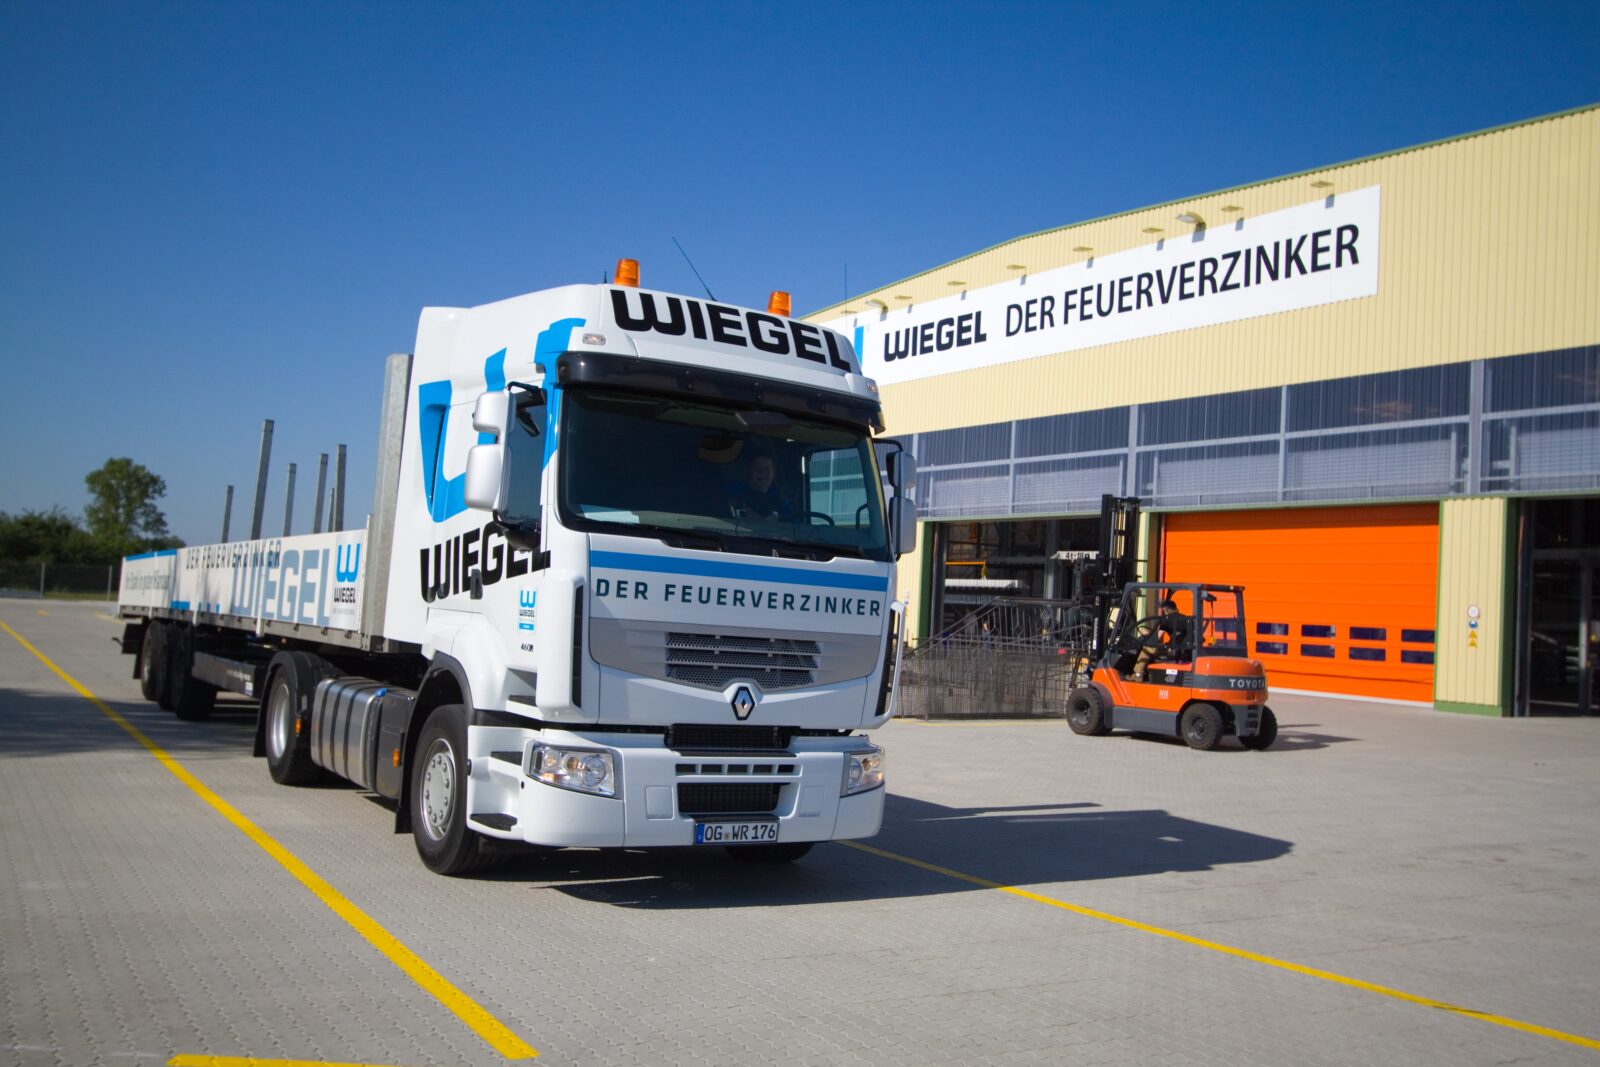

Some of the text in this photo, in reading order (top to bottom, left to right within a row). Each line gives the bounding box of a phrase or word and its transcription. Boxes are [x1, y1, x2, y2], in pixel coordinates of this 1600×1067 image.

[884, 224, 1359, 362] WIEGEL DER FEUERVERZINKER
[610, 289, 853, 373] WIEGEL
[186, 548, 199, 569] DER
[230, 549, 331, 626] WIEGEL
[334, 587, 356, 604] WIEGEL
[595, 578, 880, 617] DER FEUERVERZINKER
[1229, 678, 1265, 689] TOYOTA
[704, 824, 776, 841] OG WR 176
